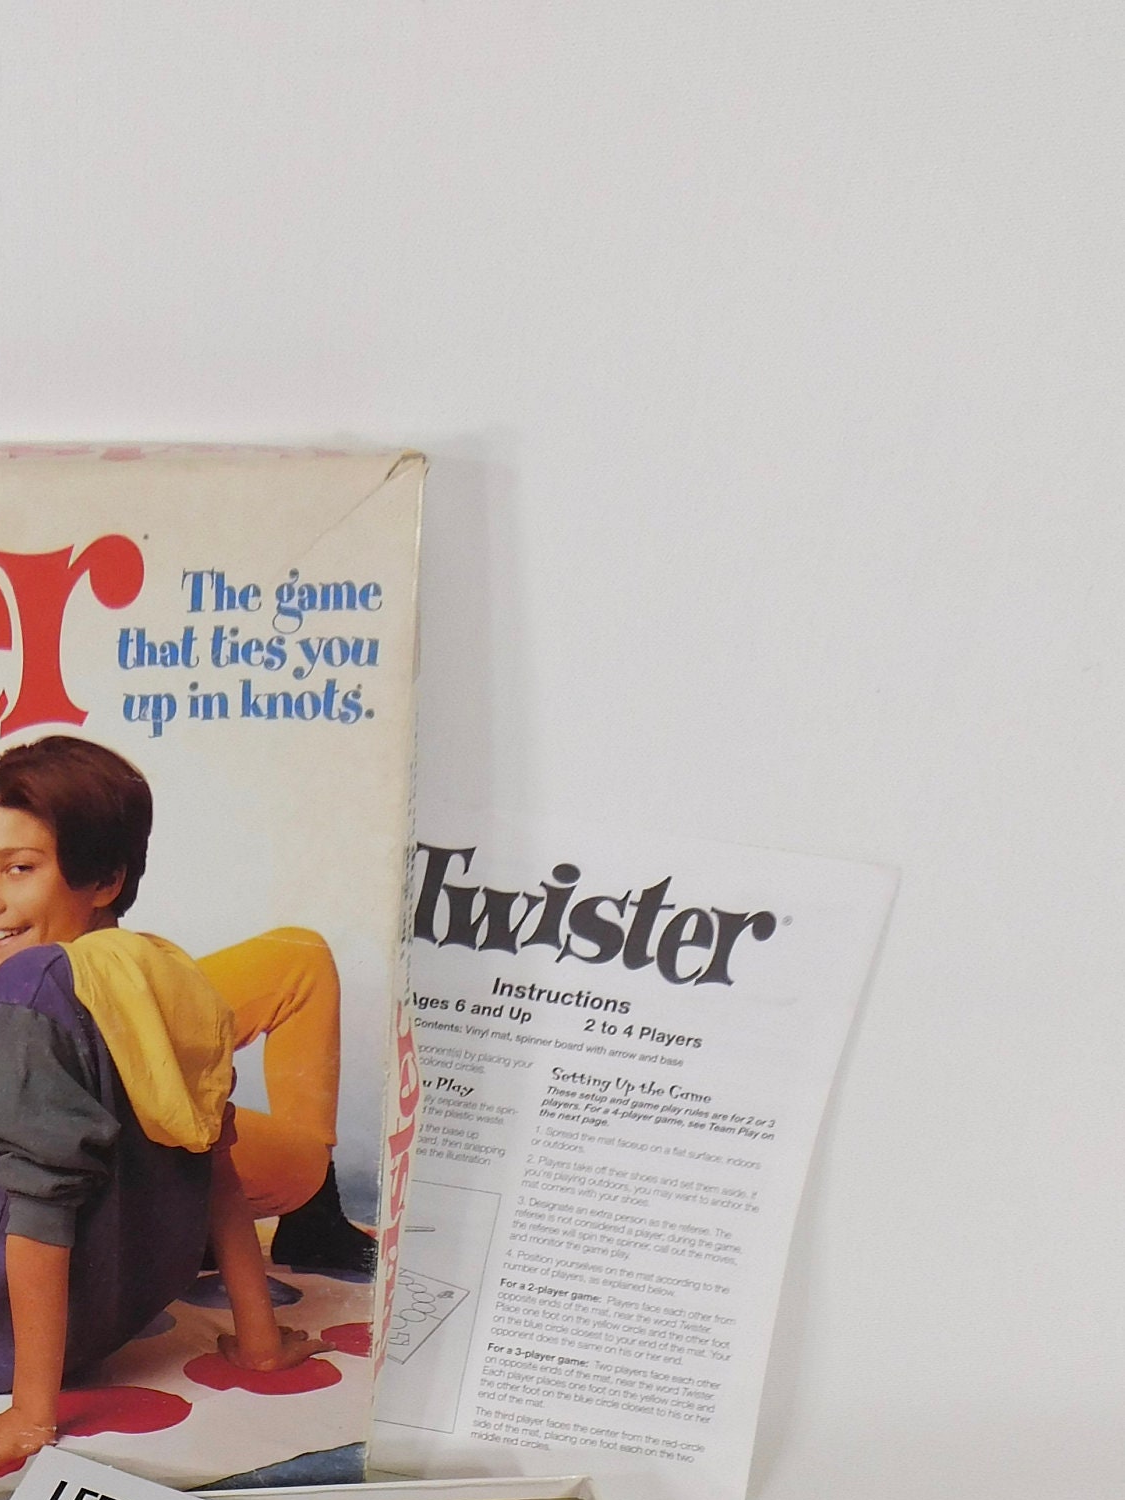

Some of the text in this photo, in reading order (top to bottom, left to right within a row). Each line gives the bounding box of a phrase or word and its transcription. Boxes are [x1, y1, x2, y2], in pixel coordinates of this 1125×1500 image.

[181, 567, 383, 634] The game
[117, 625, 379, 680] that ties you
[123, 678, 375, 738] up in knots.
[454, 998, 466, 1012] 6
[470, 1004, 504, 1017] and
[508, 1006, 531, 1024] Up
[491, 977, 630, 1014] Instructions
[413, 1017, 683, 1067] Contents: Vinyl mat, spinner board with arrow and base
[583, 1018, 702, 1048] 2 to 4 Players
[435, 1076, 474, 1096] Play
[551, 1066, 711, 1103] Setting Up the Game
[538, 1108, 607, 1126] the next page.
[546, 1085, 576, 1097] These
[629, 1100, 659, 1110] game
[659, 1104, 683, 1115] play
[711, 1112, 728, 1121] are
[729, 1113, 745, 1123] for
[745, 1116, 754, 1124] 2
[583, 1103, 601, 1112] For
[611, 1107, 653, 1121] 4-player
[653, 1115, 684, 1127] game,
[687, 1120, 706, 1129] see
[709, 1121, 735, 1133] Team
[737, 1126, 760, 1139] Play
[760, 1132, 774, 1140] on
[499, 1277, 517, 1287] For
[527, 1282, 569, 1297] 2-player
[487, 1342, 504, 1352] For
[514, 1347, 556, 1361] 3-player
